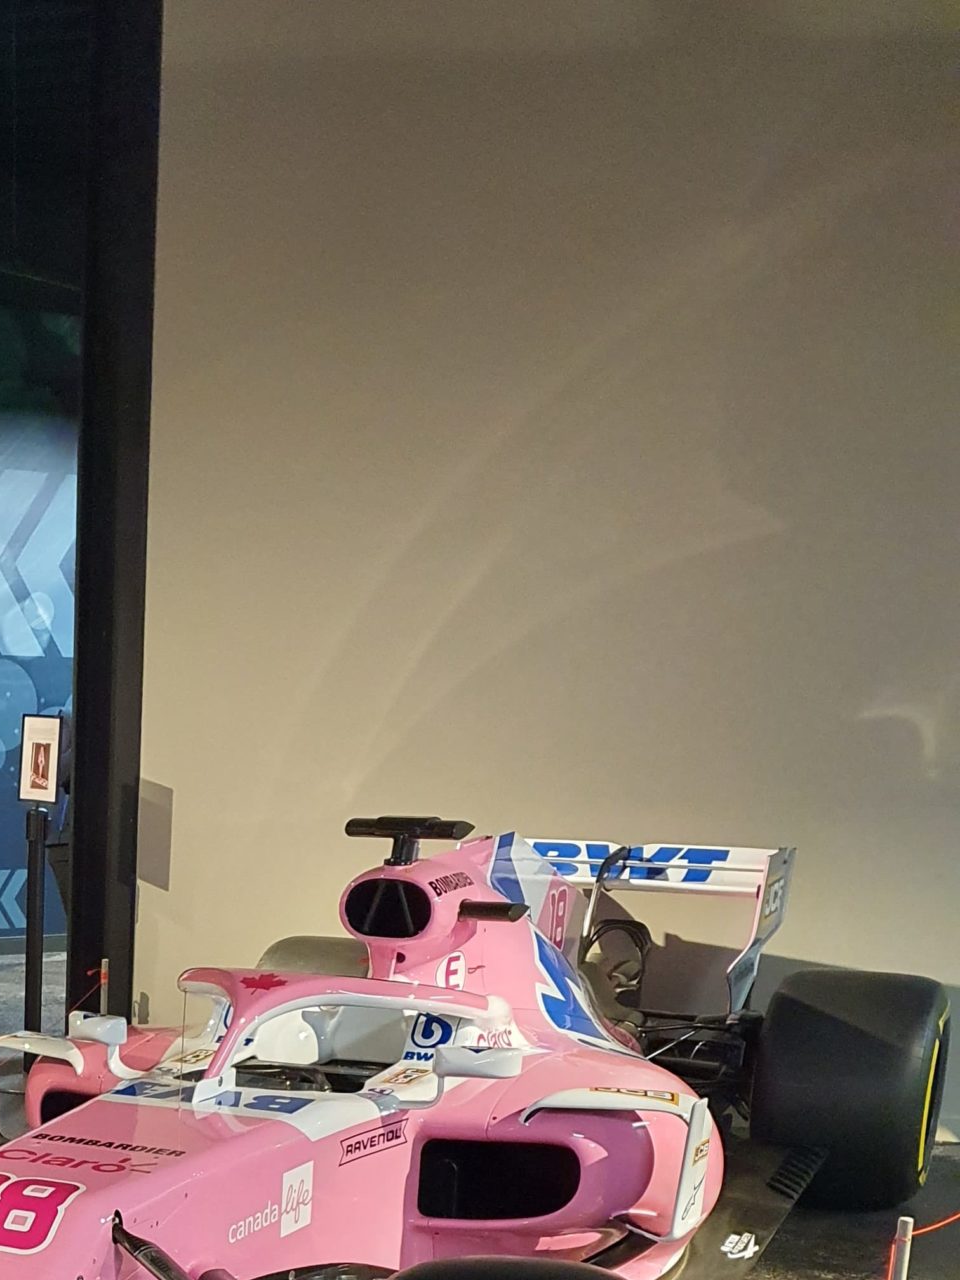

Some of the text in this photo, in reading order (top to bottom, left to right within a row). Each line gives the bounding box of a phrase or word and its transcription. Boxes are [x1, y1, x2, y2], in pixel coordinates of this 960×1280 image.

[533, 842, 730, 882] BWT
[403, 1051, 434, 1061] BW
[31, 1133, 186, 1157] BOMBARDIER
[345, 1128, 402, 1156] RAVENOL
[228, 1178, 313, 1244] canada life
